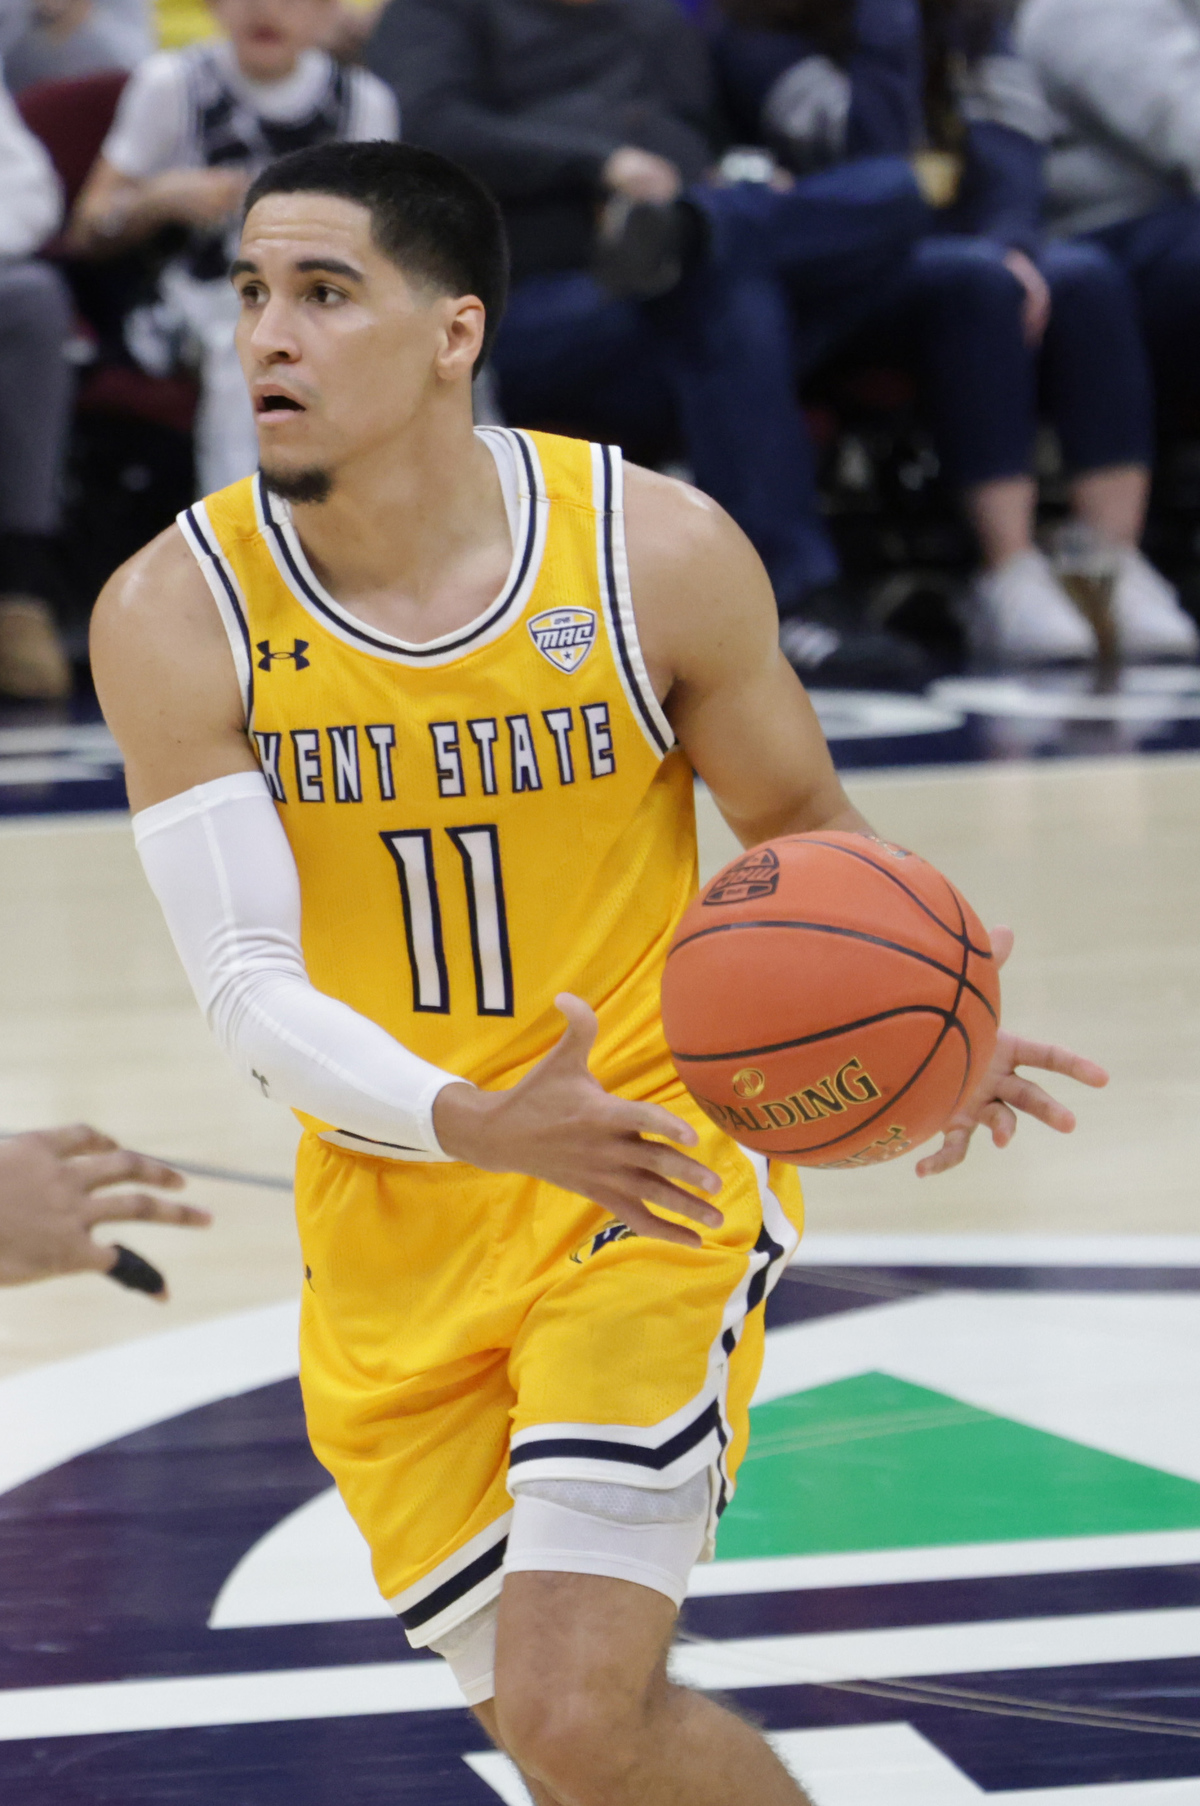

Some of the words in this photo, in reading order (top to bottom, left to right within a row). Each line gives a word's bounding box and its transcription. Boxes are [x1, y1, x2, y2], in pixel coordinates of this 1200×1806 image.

[536, 625, 594, 649] MAC
[253, 723, 397, 803] KENT
[429, 702, 616, 797] STATE
[378, 824, 515, 1018] 11
